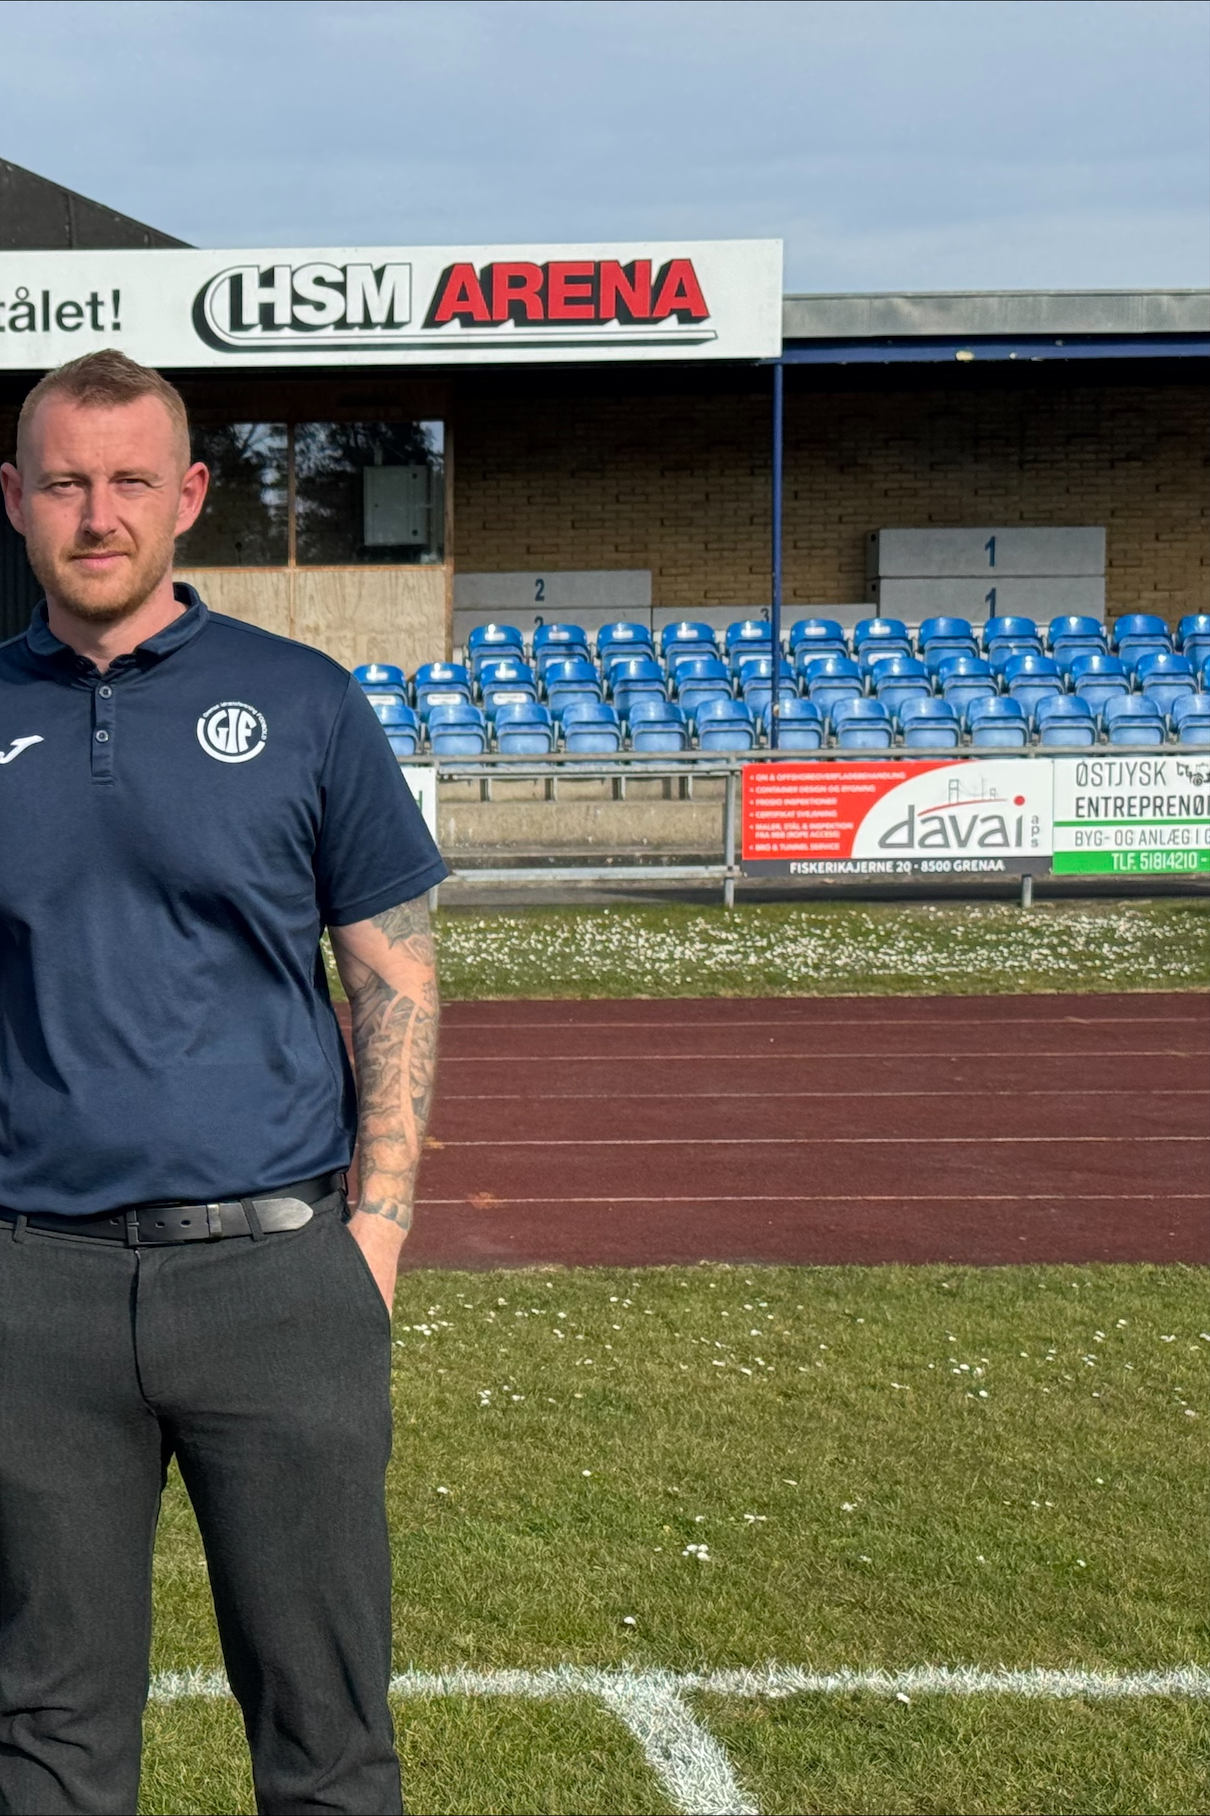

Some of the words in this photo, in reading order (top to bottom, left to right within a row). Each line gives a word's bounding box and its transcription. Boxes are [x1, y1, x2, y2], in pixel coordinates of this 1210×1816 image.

[230, 262, 412, 332] HSM
[422, 258, 711, 329] ARENA
[984, 535, 997, 567] 1
[534, 578, 546, 603] 2
[984, 587, 997, 618] 1
[207, 708, 257, 753] GIF
[1075, 761, 1167, 787] ØSTJYSK
[878, 795, 1026, 849] davai
[1075, 830, 1110, 847] BYG-
[1114, 830, 1134, 846] OG
[1138, 829, 1190, 846] ANLÆG
[790, 862, 894, 874] FISKERIKAJERNE
[896, 861, 911, 873] 20
[920, 861, 950, 873] 8500
[953, 860, 1005, 872] GRENAA
[1111, 853, 1137, 871] TLF.
[1139, 852, 1198, 870] 51814210
